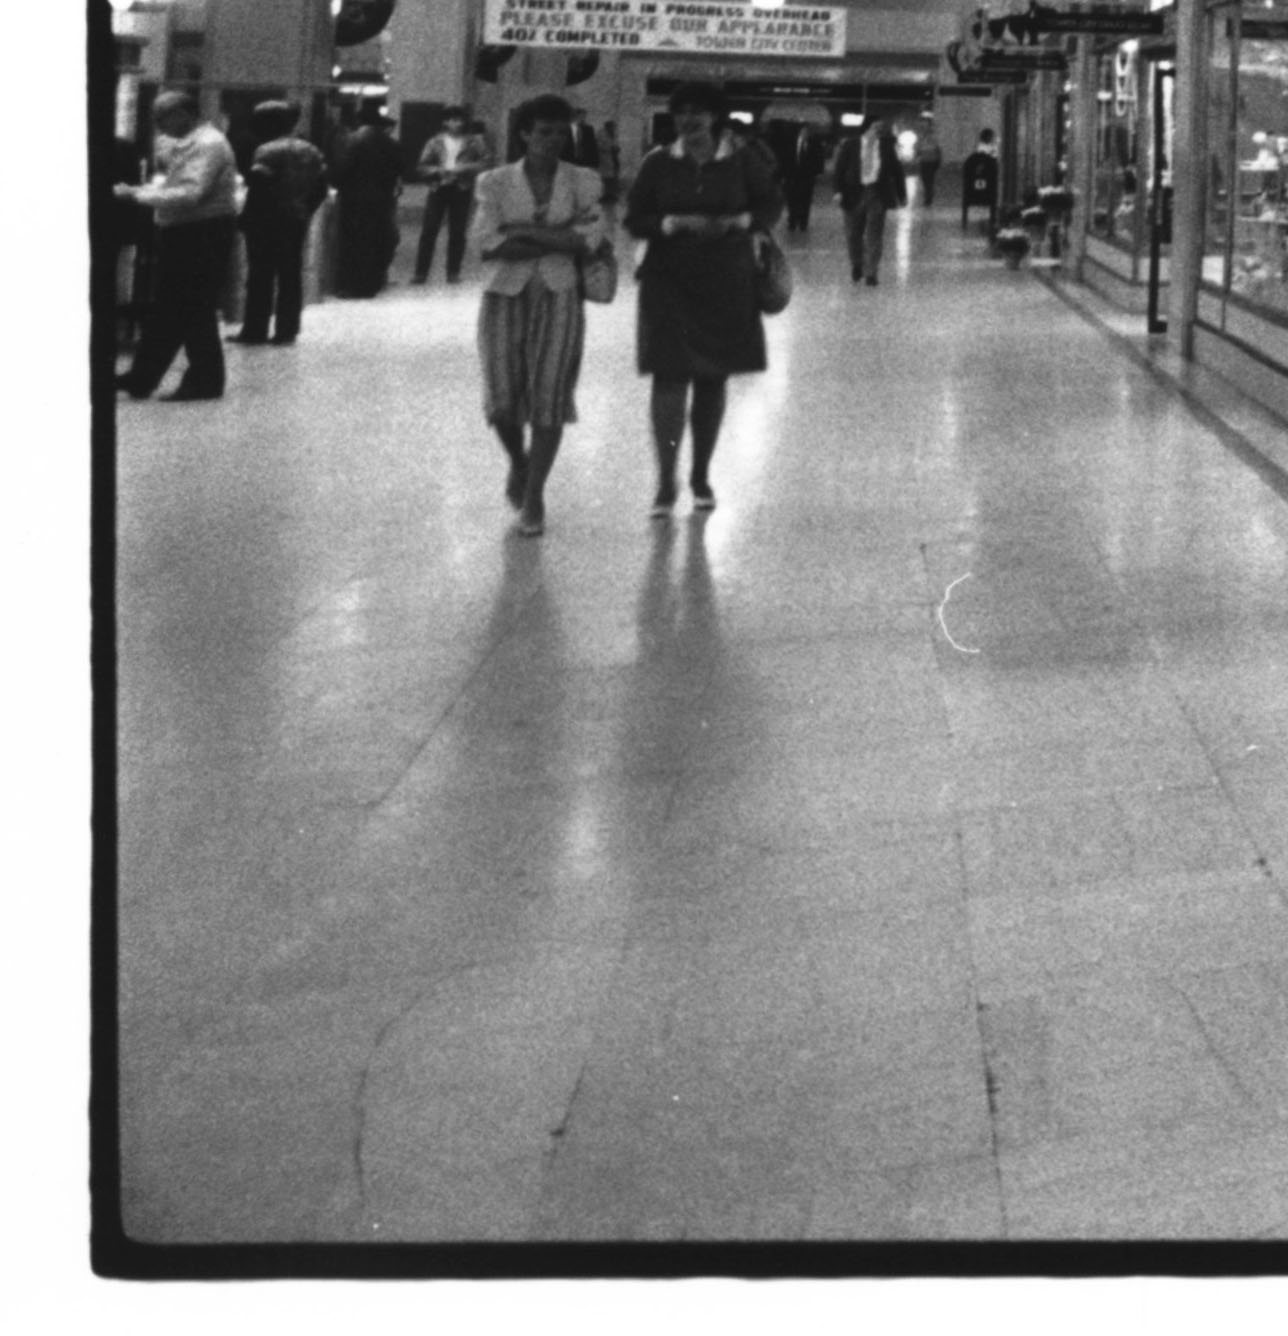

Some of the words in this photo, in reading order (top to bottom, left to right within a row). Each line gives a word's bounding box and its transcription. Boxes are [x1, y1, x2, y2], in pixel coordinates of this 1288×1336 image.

[576, 0, 630, 13] REPAIR
[639, 2, 657, 14] IN
[665, 3, 745, 18] PROGRESS
[753, 7, 831, 21] OVERHEAD
[500, 10, 573, 27] PLEASE
[584, 14, 659, 31] EXCUSE
[669, 18, 708, 33] OUR
[717, 19, 834, 38] APPEARANCE
[545, 29, 640, 46] COMPLETED
